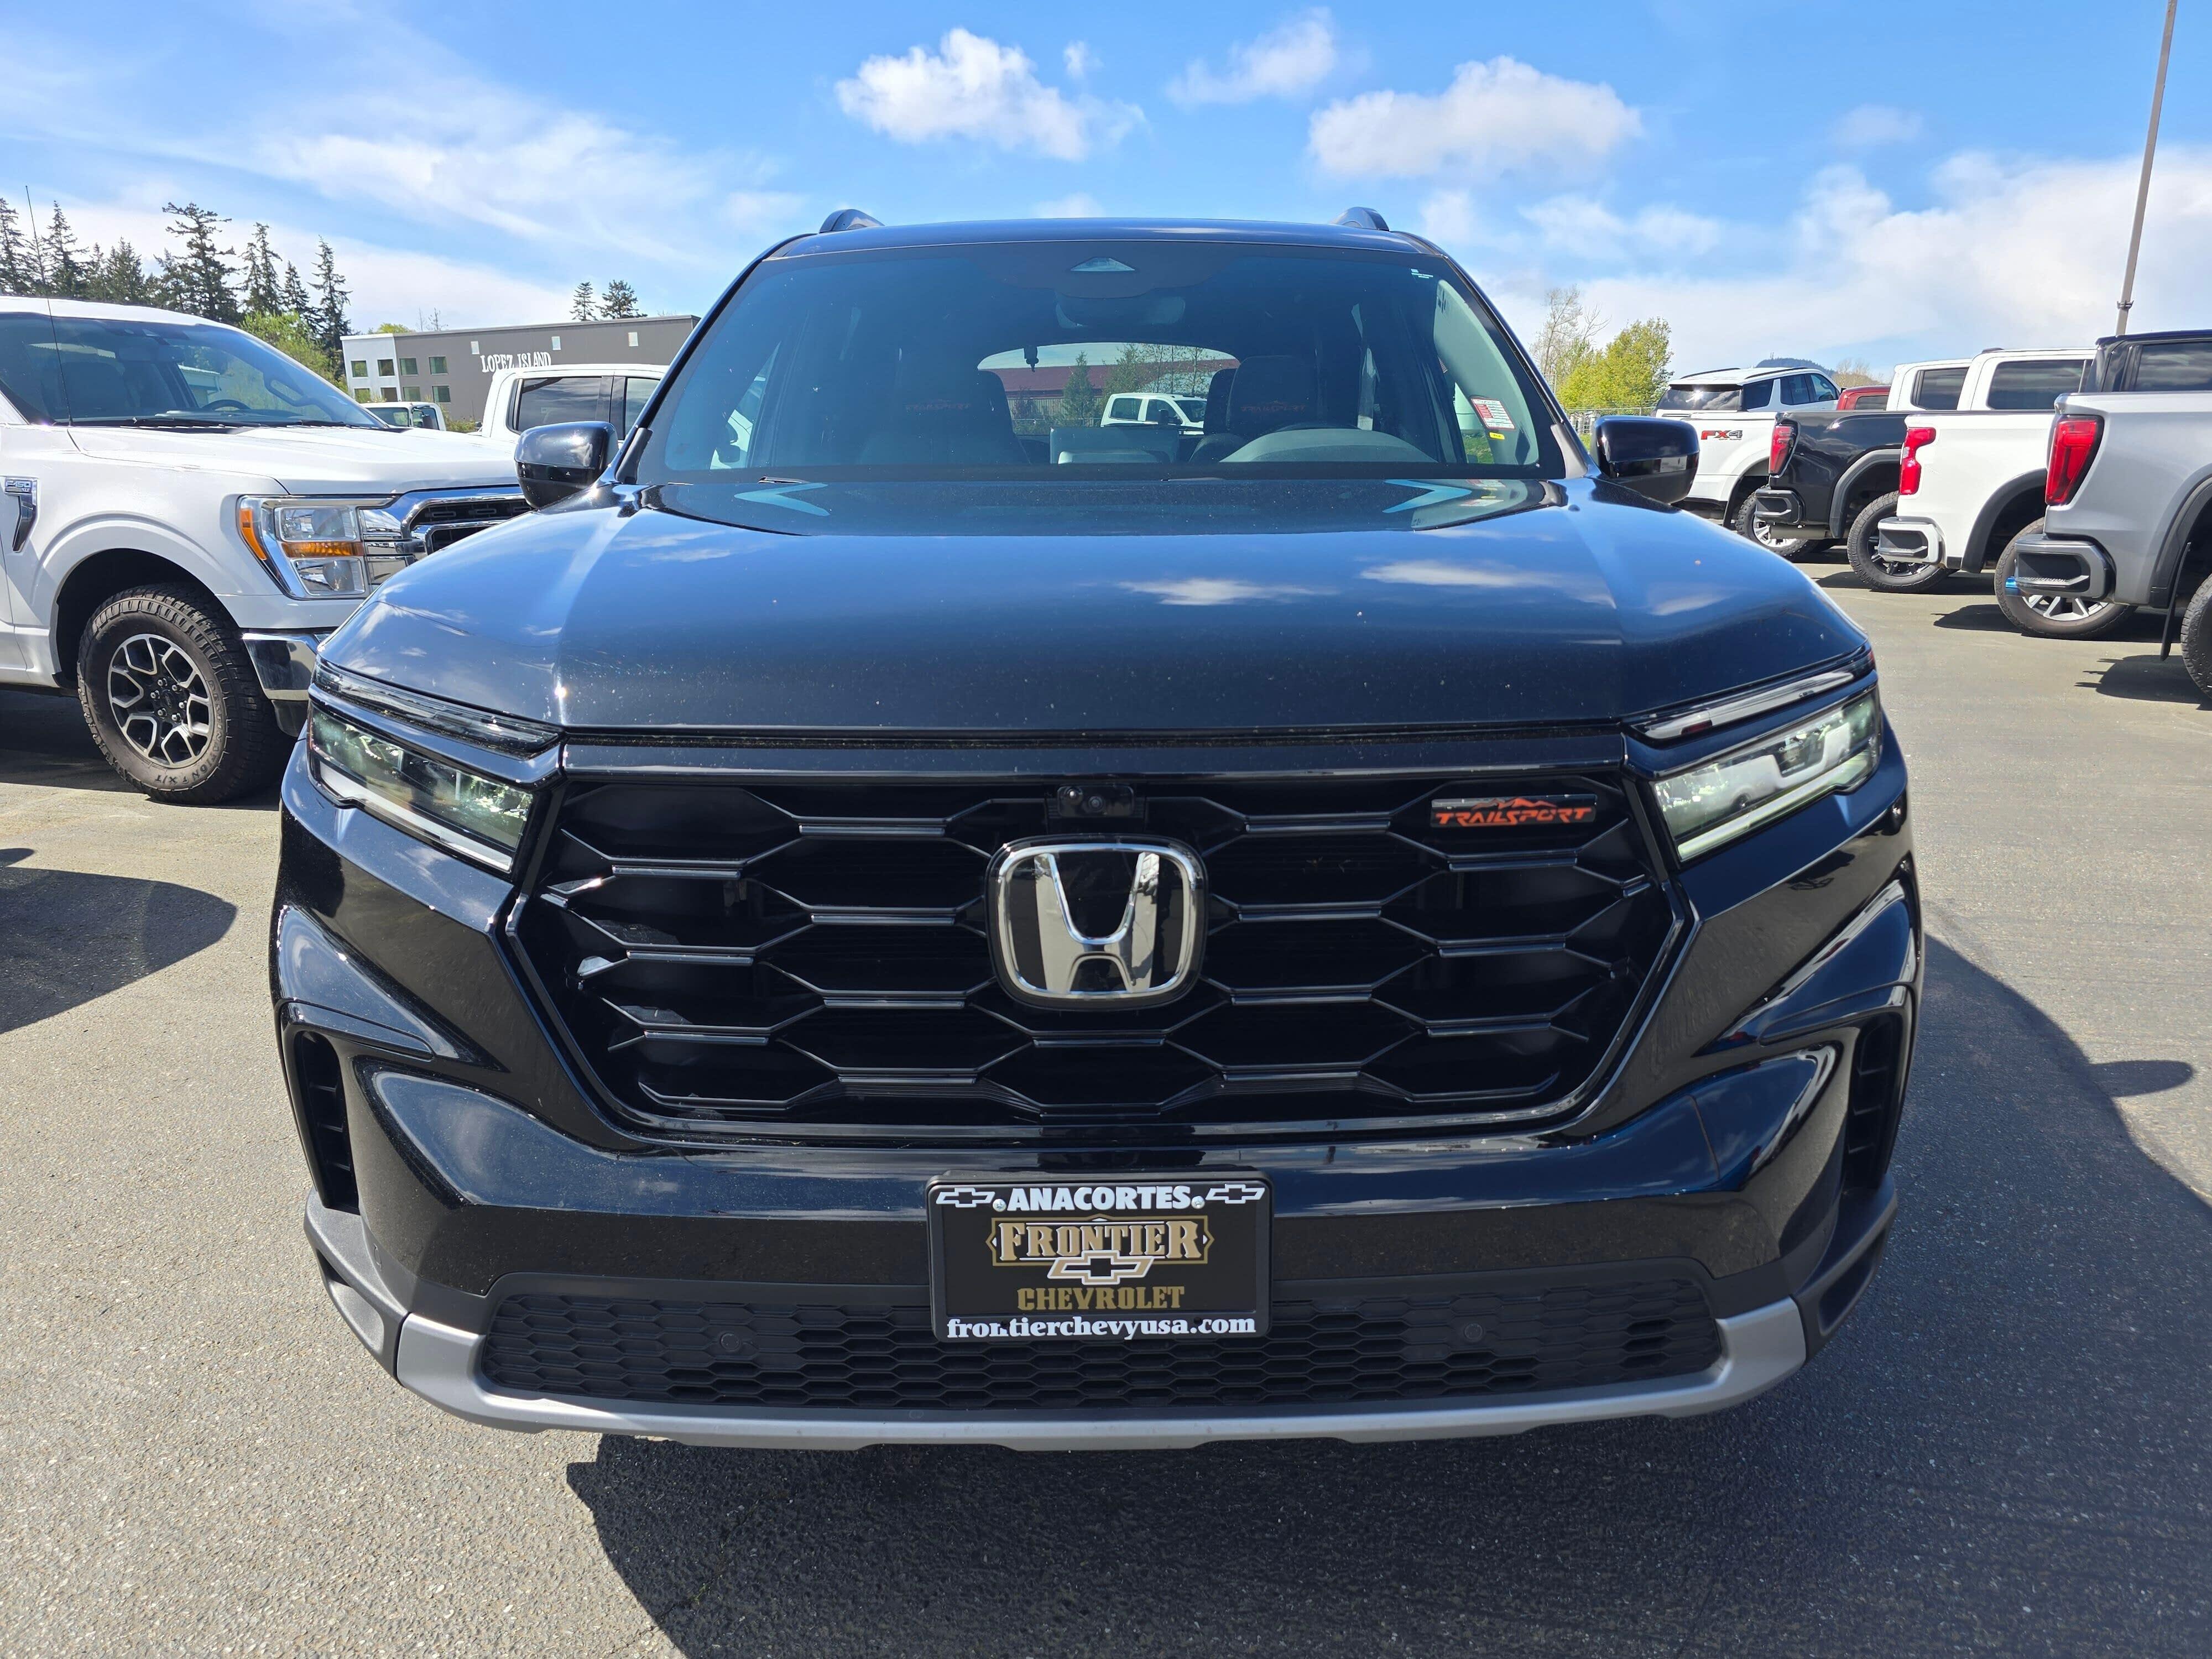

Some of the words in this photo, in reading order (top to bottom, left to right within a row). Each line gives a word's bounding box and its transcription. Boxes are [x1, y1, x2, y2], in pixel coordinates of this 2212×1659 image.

[480, 354, 514, 373] LOPEZ
[517, 351, 551, 368] ISLAND
[1701, 430, 1743, 440] FX4
[1435, 807, 1592, 827] TRAILSPORT
[1006, 1185, 1191, 1211] ANACORTES
[998, 1220, 1202, 1261] FRONTIER
[1016, 1286, 1185, 1311] CHEVROLET
[947, 1316, 1256, 1340] frontierchevyusa.com
